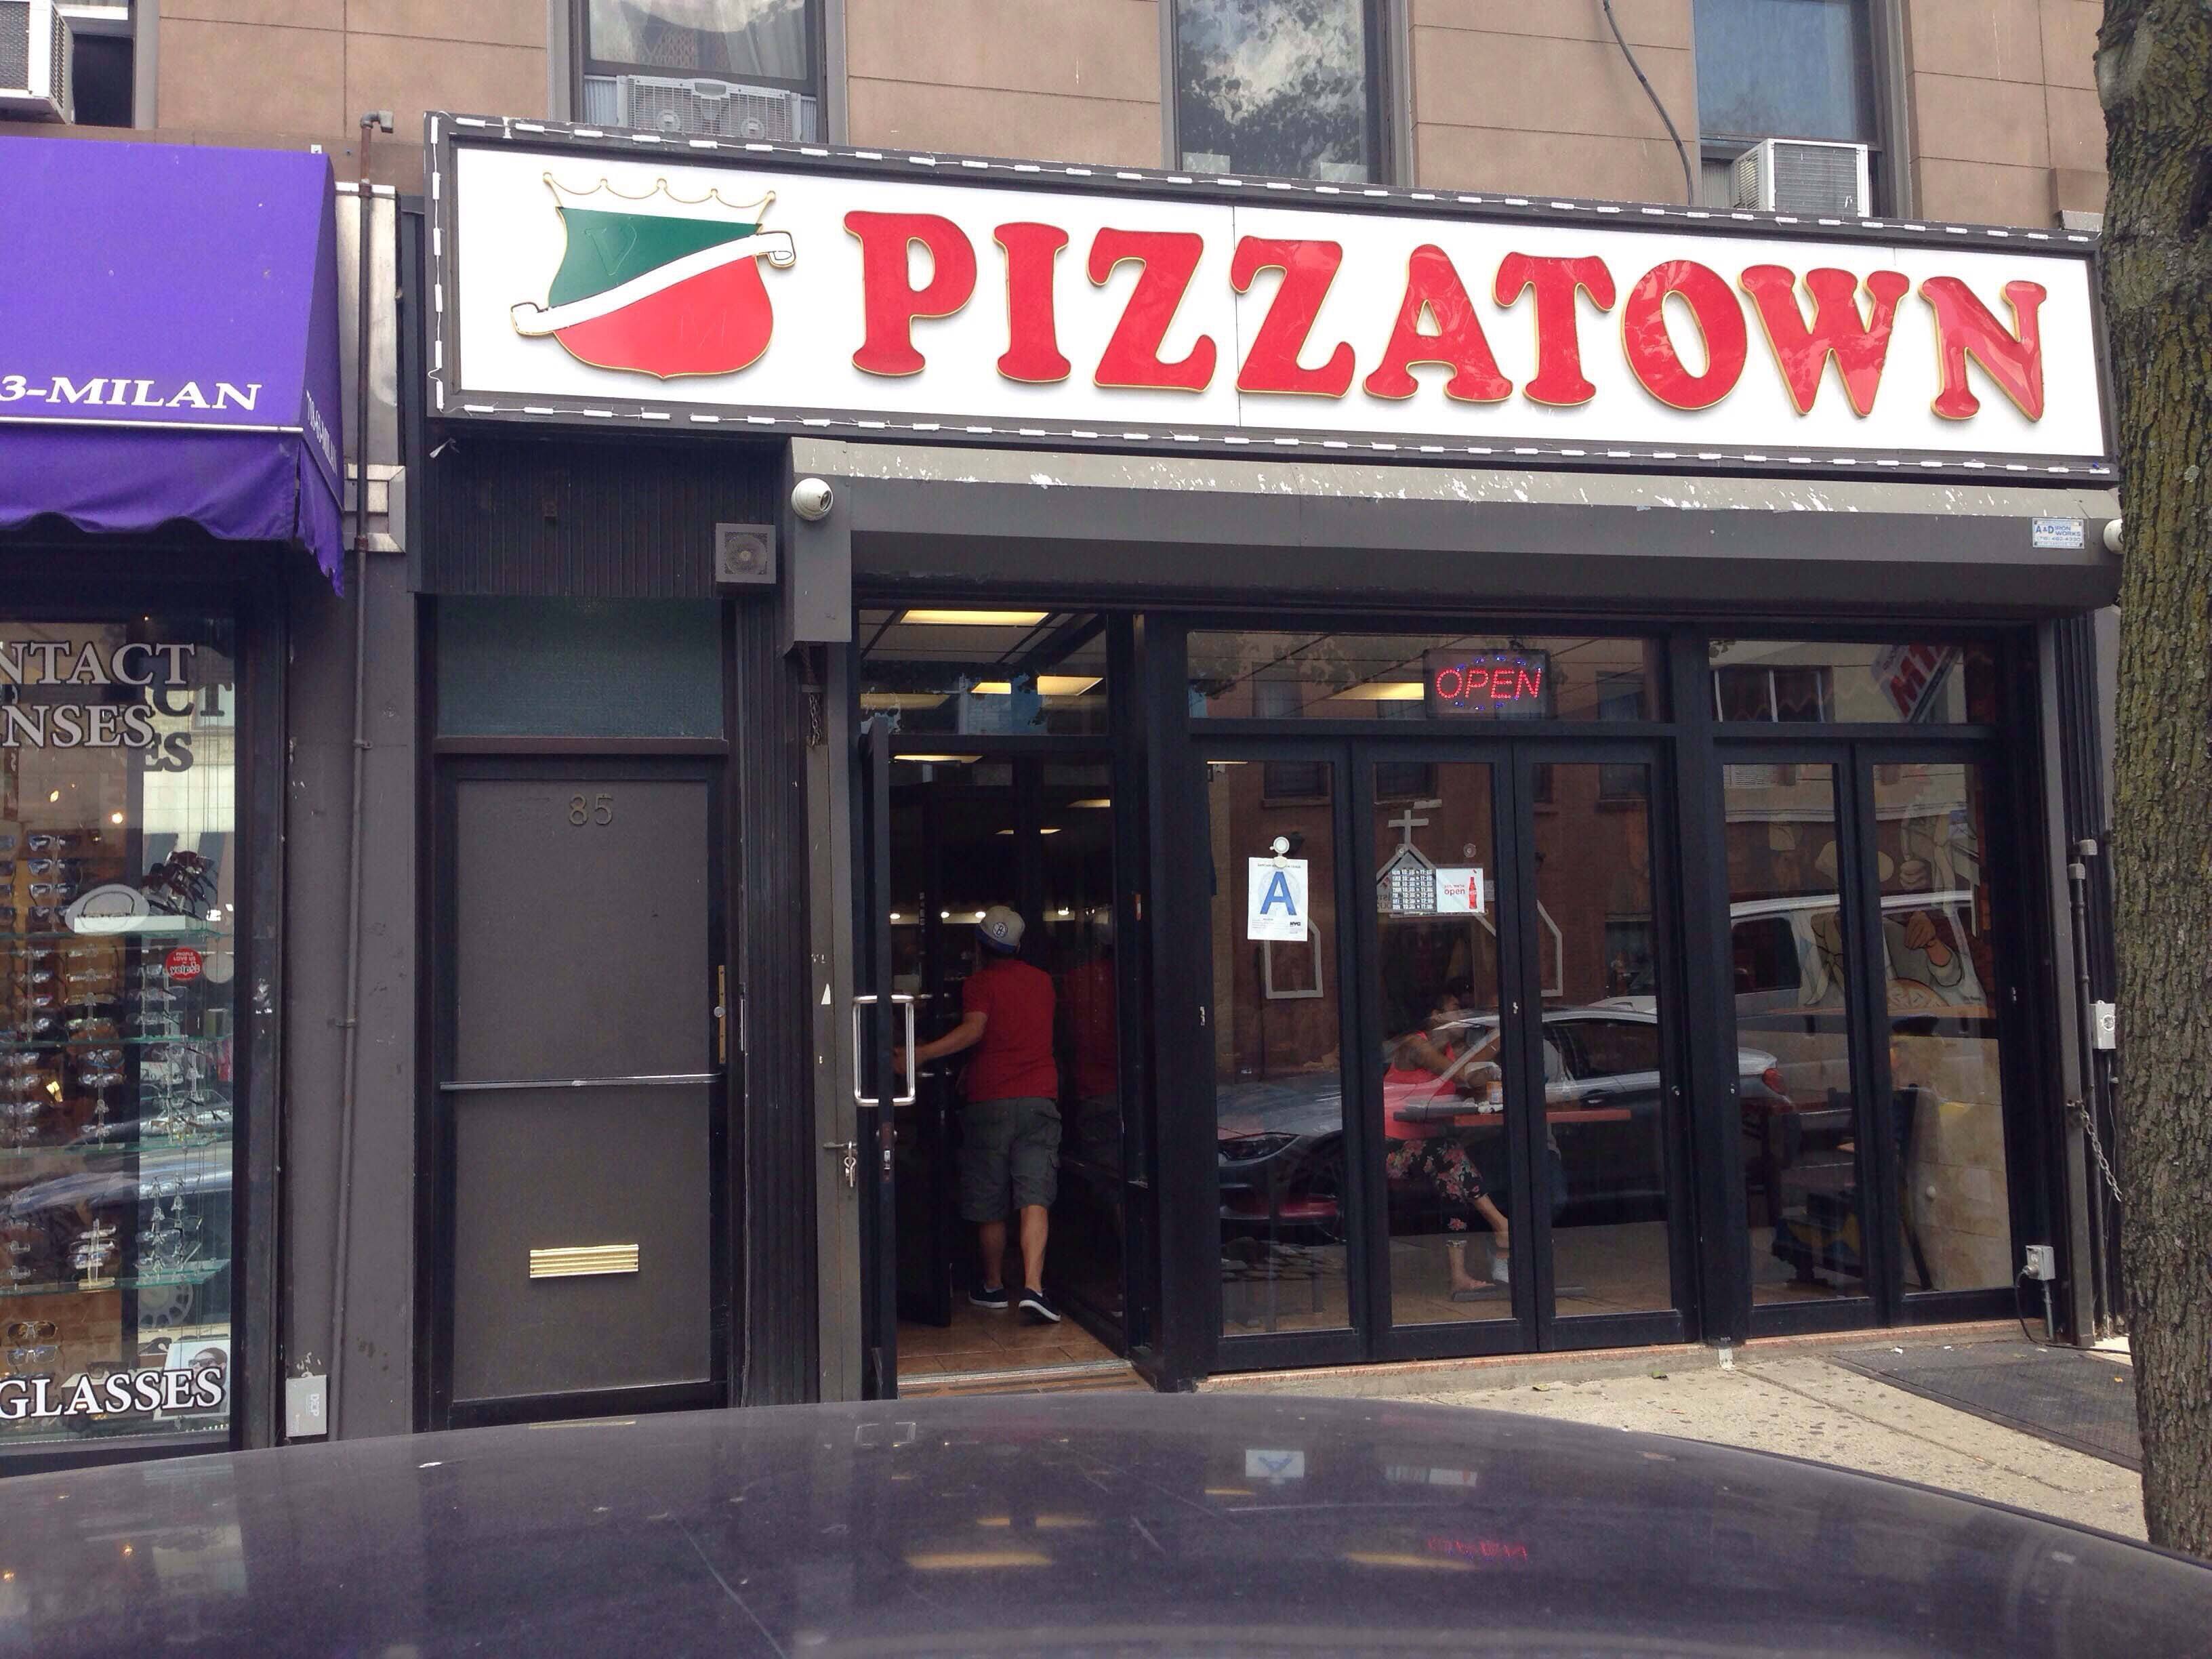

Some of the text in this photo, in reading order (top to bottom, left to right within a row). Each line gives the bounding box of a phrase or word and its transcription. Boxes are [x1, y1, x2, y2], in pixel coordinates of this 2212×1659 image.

[842, 210, 2047, 423] PIZZATOWN
[1436, 668, 1542, 699] OPEN
[569, 793, 613, 826] 85
[1260, 871, 1297, 916] A
[1444, 888, 1465, 897] open
[0, 1367, 223, 1420] GLASSES
